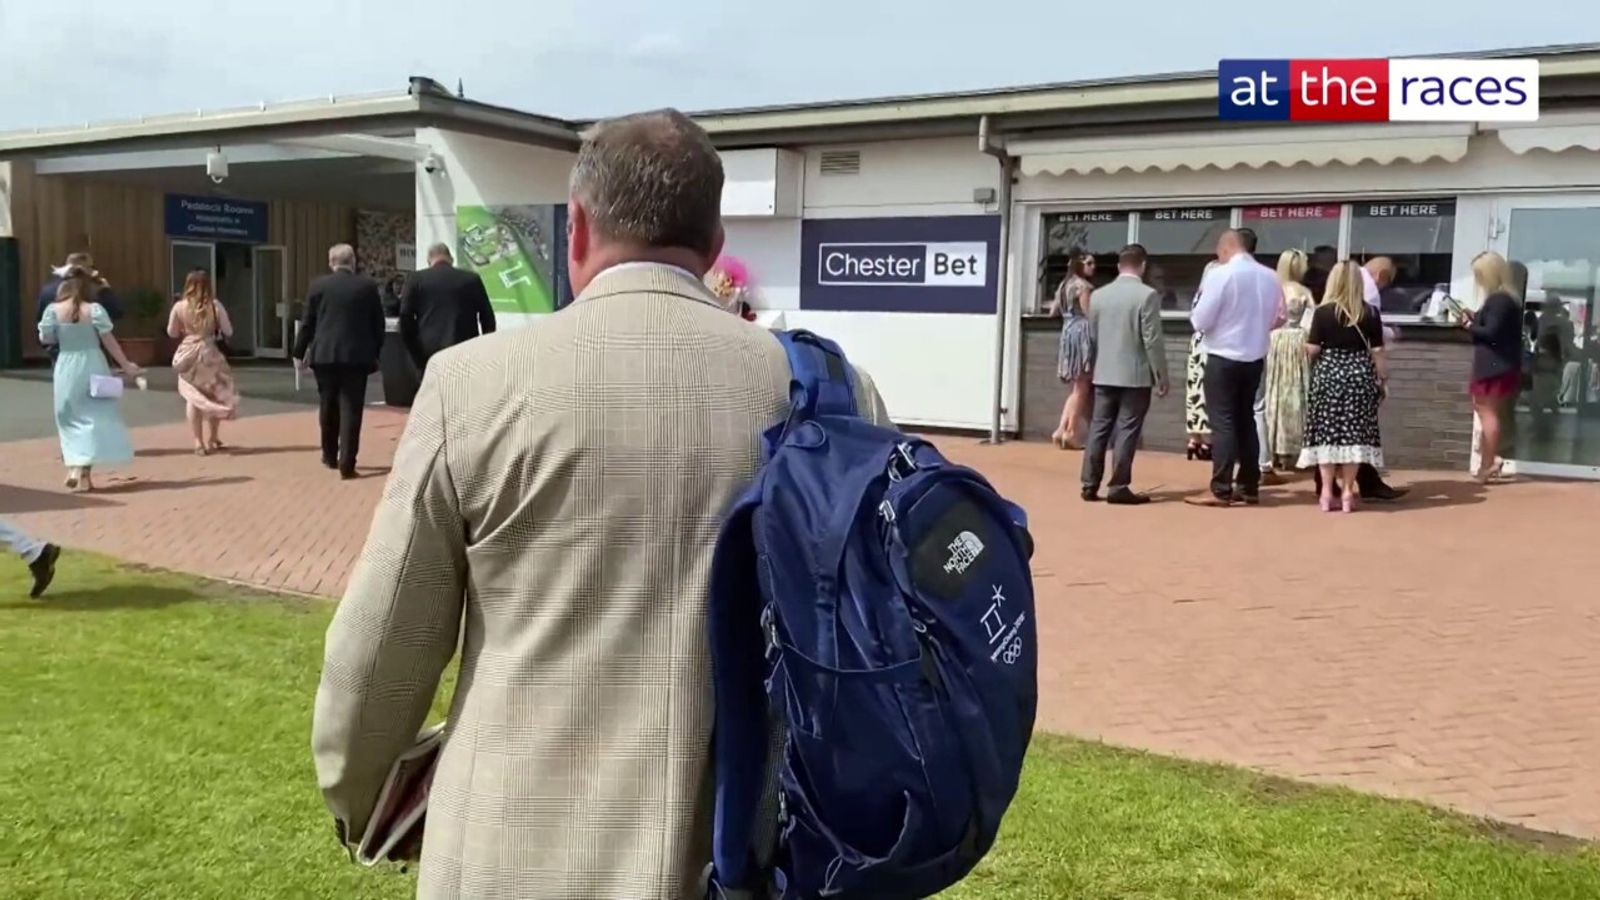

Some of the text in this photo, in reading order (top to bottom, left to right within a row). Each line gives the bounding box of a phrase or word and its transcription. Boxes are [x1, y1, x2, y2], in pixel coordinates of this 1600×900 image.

[1155, 208, 1213, 220] BET HERE
[1260, 205, 1323, 218] BET HERE
[1370, 203, 1438, 216] BET HERE
[825, 252, 978, 277] Chester Bet
[947, 535, 963, 554] THE
[943, 544, 970, 574] NORTH
[956, 551, 976, 575] FACE
